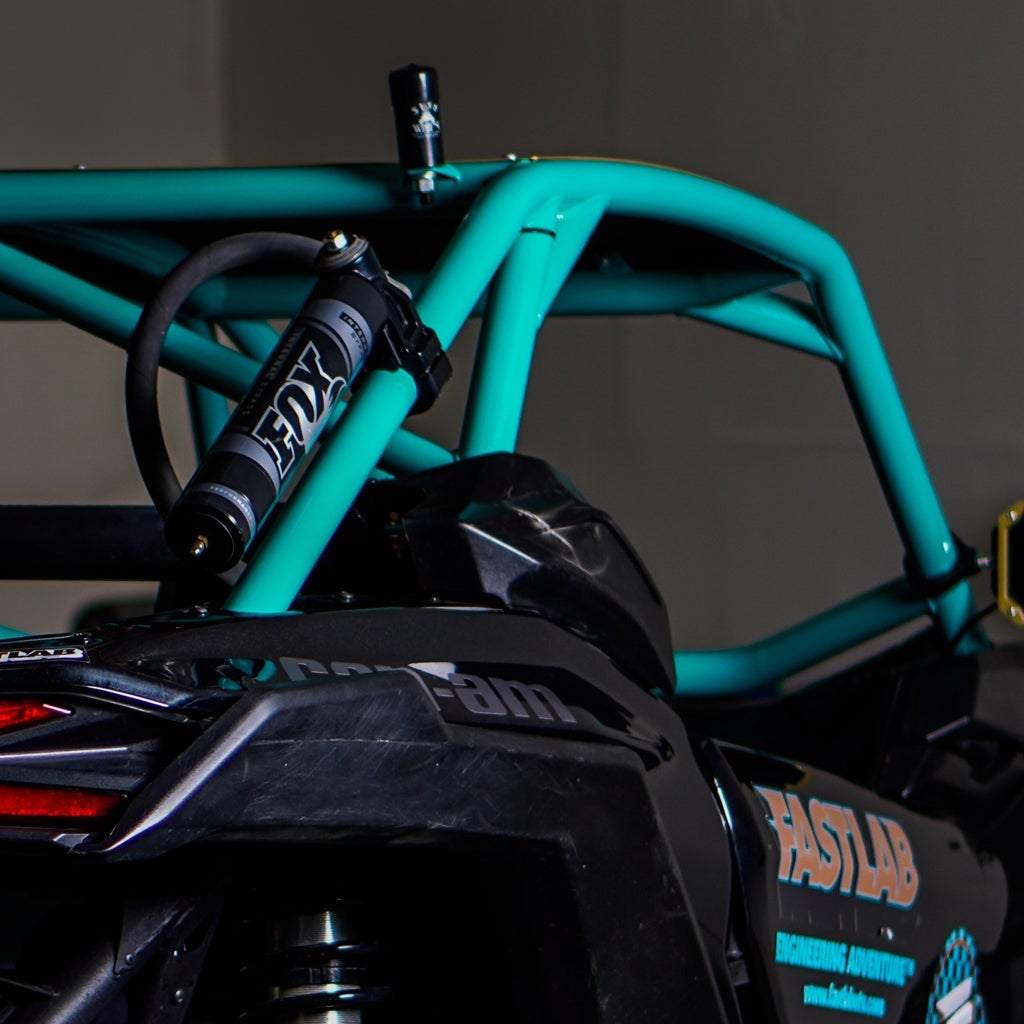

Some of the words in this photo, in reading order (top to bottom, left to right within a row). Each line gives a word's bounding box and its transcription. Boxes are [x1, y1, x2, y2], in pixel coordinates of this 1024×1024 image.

[251, 340, 336, 479] FOX
[753, 783, 920, 911] FASTLAB
[775, 931, 848, 976] ENGINEERING
